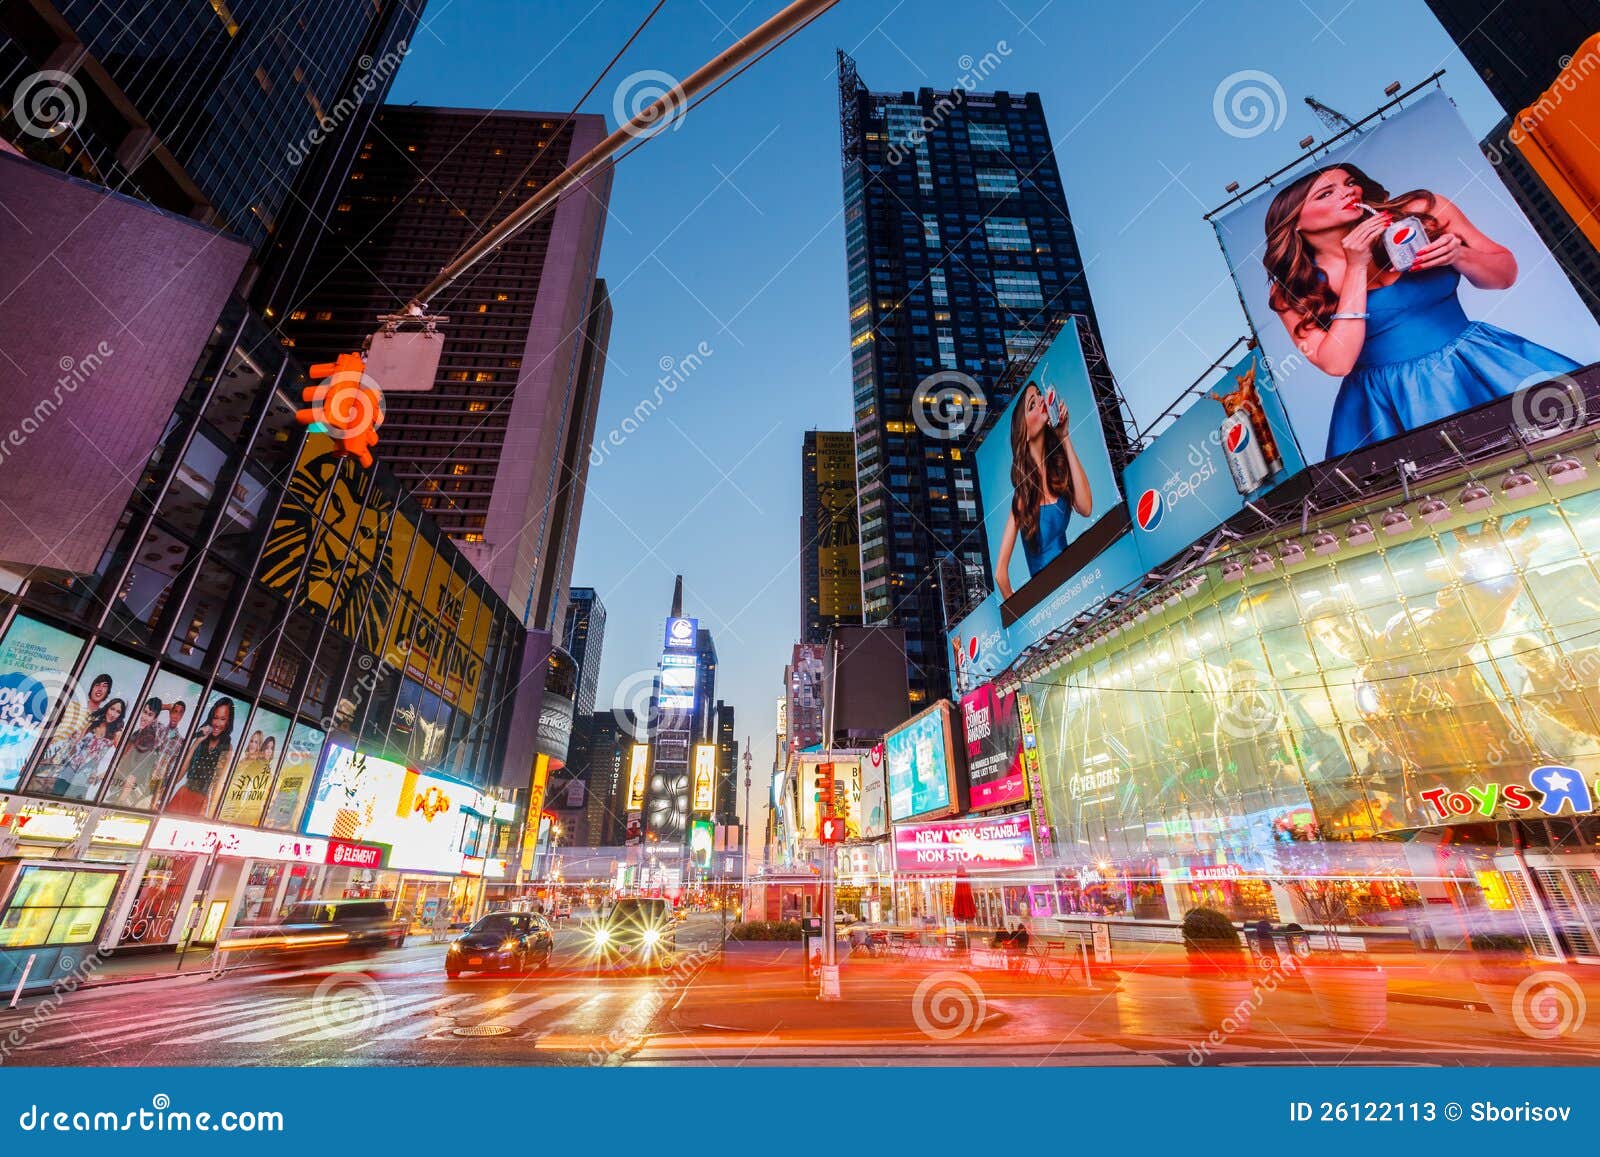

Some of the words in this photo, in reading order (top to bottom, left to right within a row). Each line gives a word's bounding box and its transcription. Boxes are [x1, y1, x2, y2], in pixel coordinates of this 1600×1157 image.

[1167, 457, 1218, 512] pepsi
[1081, 574, 1094, 589] like
[438, 584, 461, 622] THE
[0, 687, 32, 706] OW
[965, 700, 976, 714] THE
[966, 706, 990, 730] COMEDY
[967, 722, 991, 744] AWARDS
[612, 756, 621, 796] NOVOTEL
[1421, 783, 1533, 819] TOYS
[526, 784, 543, 840] Kodak
[916, 830, 943, 844] NEW
[945, 823, 1021, 842] YORK-ISTANBUL
[343, 847, 378, 865] ELEMENT
[917, 848, 945, 863] NON
[129, 899, 180, 919] BILLA
